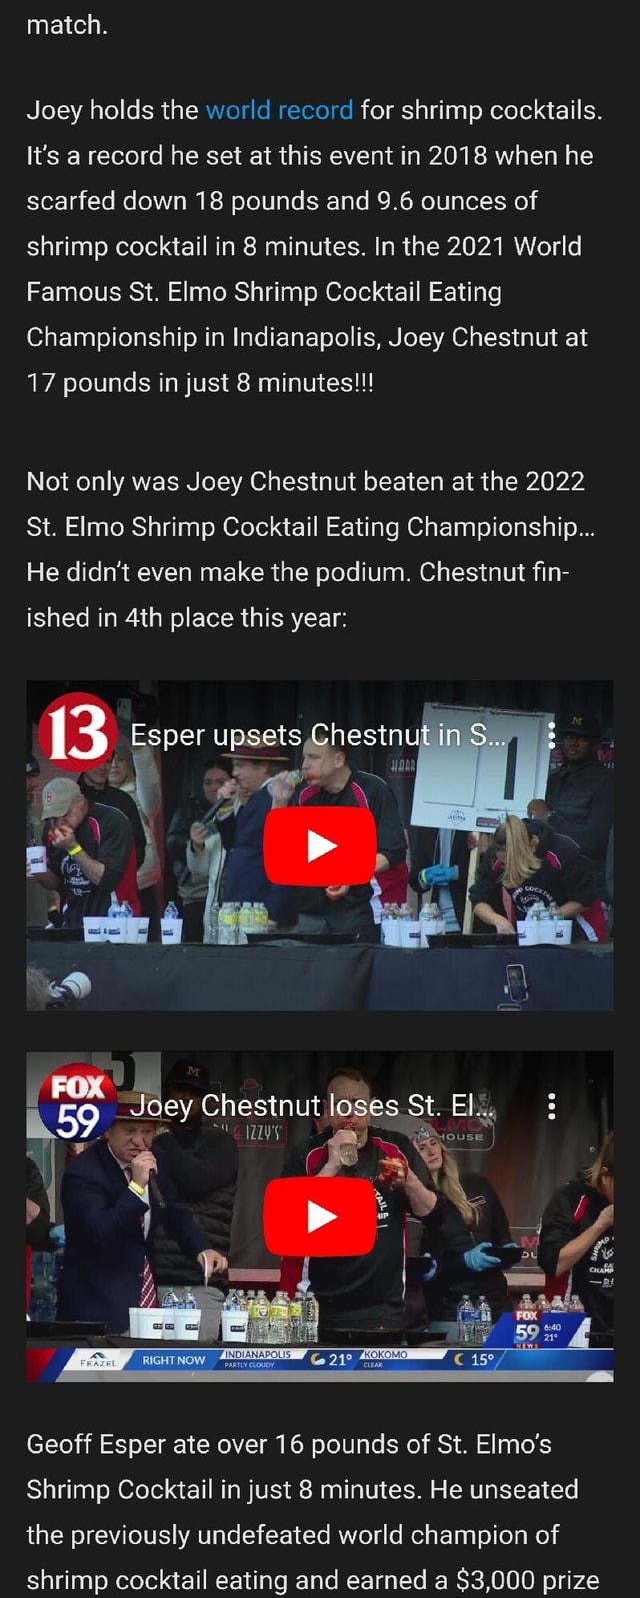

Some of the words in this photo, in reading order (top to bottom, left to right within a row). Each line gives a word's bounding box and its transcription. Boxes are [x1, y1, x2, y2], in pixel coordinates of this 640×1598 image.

[26, 99, 84, 126] Joey
[90, 98, 154, 121] holds
[160, 98, 199, 121] the
[205, 98, 271, 121] world
[278, 98, 354, 121] record
[360, 98, 395, 121] for
[400, 98, 483, 126] shrimp
[490, 98, 603, 121] cocktails.
[26, 325, 198, 353] Championship
[205, 326, 225, 347] in
[233, 325, 382, 353] Indianapolis,
[388, 326, 446, 353] Joey
[452, 325, 559, 348] Chestnut
[565, 328, 589, 348] at
[49, 704, 109, 760] 13
[390, 758, 416, 773] HARR
[51, 1075, 106, 1099] FOX
[56, 1103, 100, 1139] 59
[26, 1477, 110, 1505] Shrimp
[118, 1477, 213, 1500] Cocktail
[221, 1478, 241, 1500] in
[246, 1478, 292, 1505] just
[299, 1478, 313, 1500] 8
[320, 1478, 422, 1500] minutes.
[430, 1479, 463, 1500] He
[469, 1477, 579, 1500] unseated
